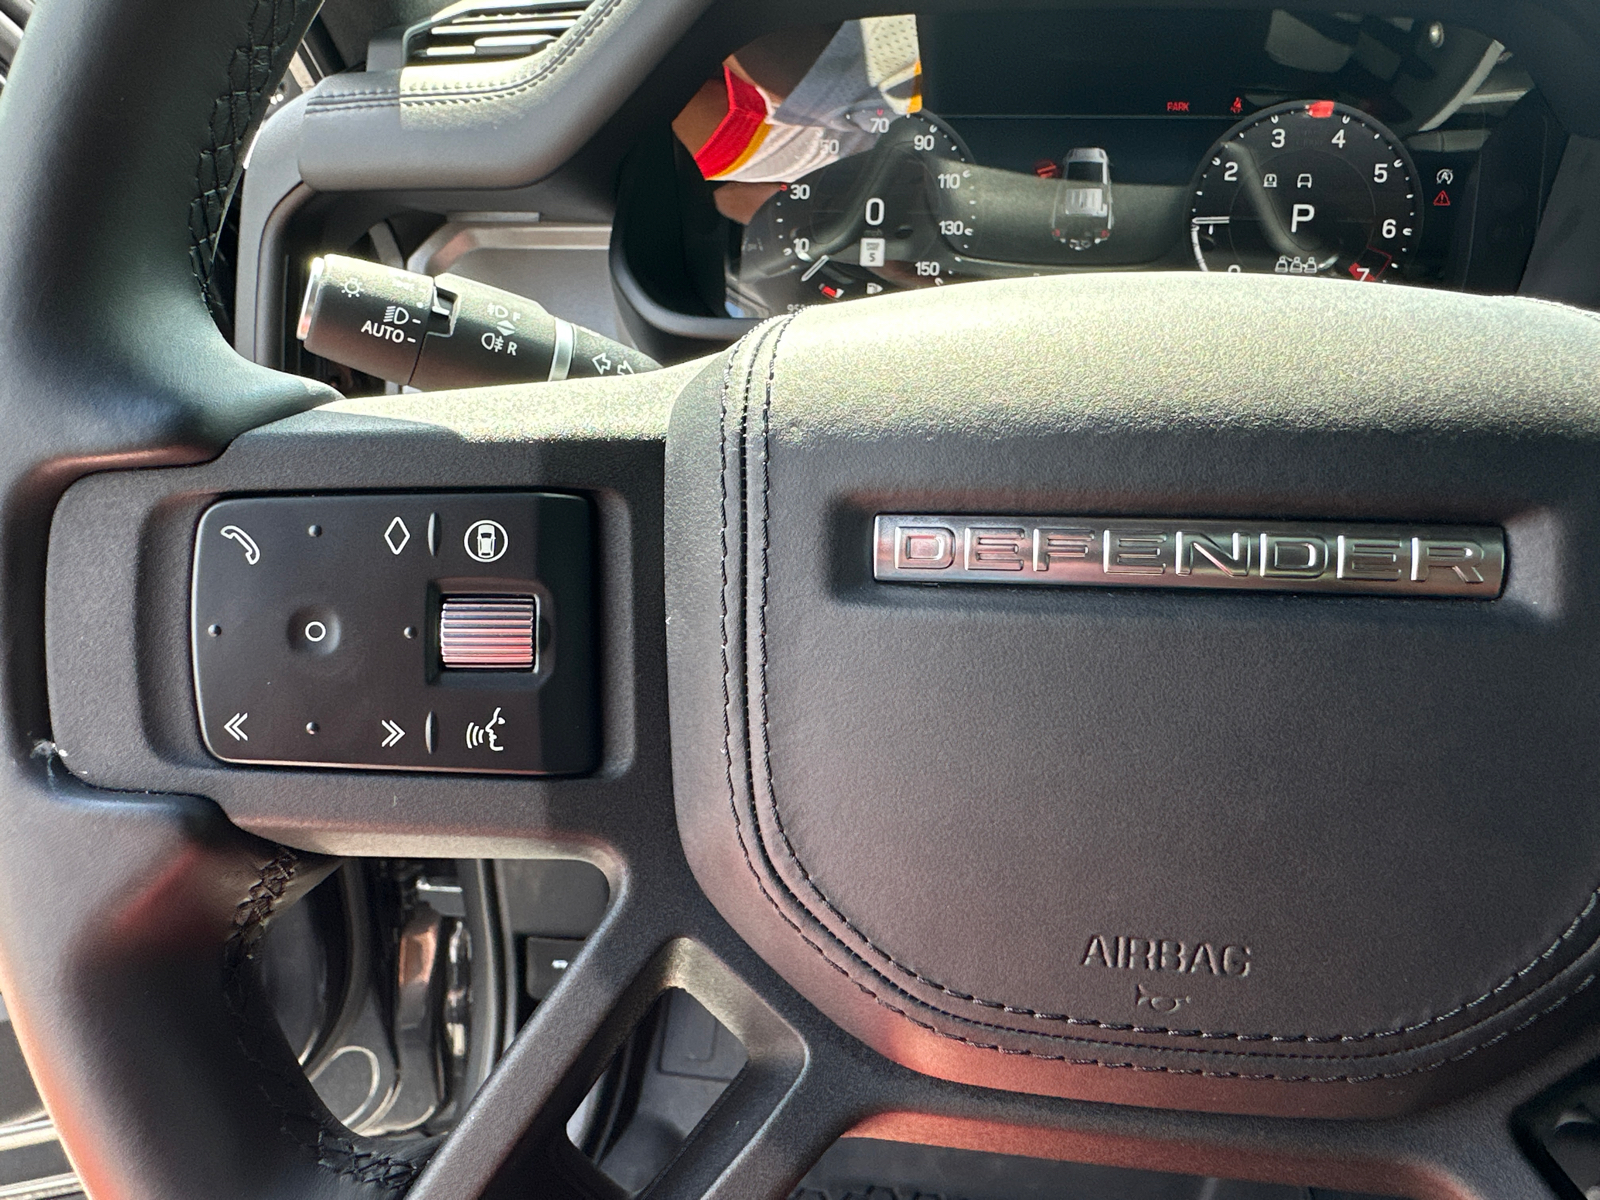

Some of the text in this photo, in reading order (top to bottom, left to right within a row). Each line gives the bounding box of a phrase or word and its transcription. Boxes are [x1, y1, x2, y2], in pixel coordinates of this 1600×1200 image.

[1166, 101, 1190, 112] PARK
[869, 118, 889, 134] 70
[914, 135, 935, 151] 90
[1271, 128, 1286, 148] 3
[1331, 129, 1346, 148] 4
[938, 173, 961, 189] 110
[1224, 161, 1238, 182] 2
[1373, 163, 1388, 183] 5
[790, 184, 810, 200] 30
[865, 197, 885, 226] 0
[1291, 203, 1315, 233] P
[939, 220, 964, 236] 130
[1381, 218, 1397, 239] 6
[793, 237, 810, 253] 10
[915, 261, 940, 277] 150
[361, 319, 405, 344] AUTO
[507, 342, 518, 356] R
[894, 525, 1485, 584] DEFENDER
[1083, 934, 1250, 977] AIRBAG
